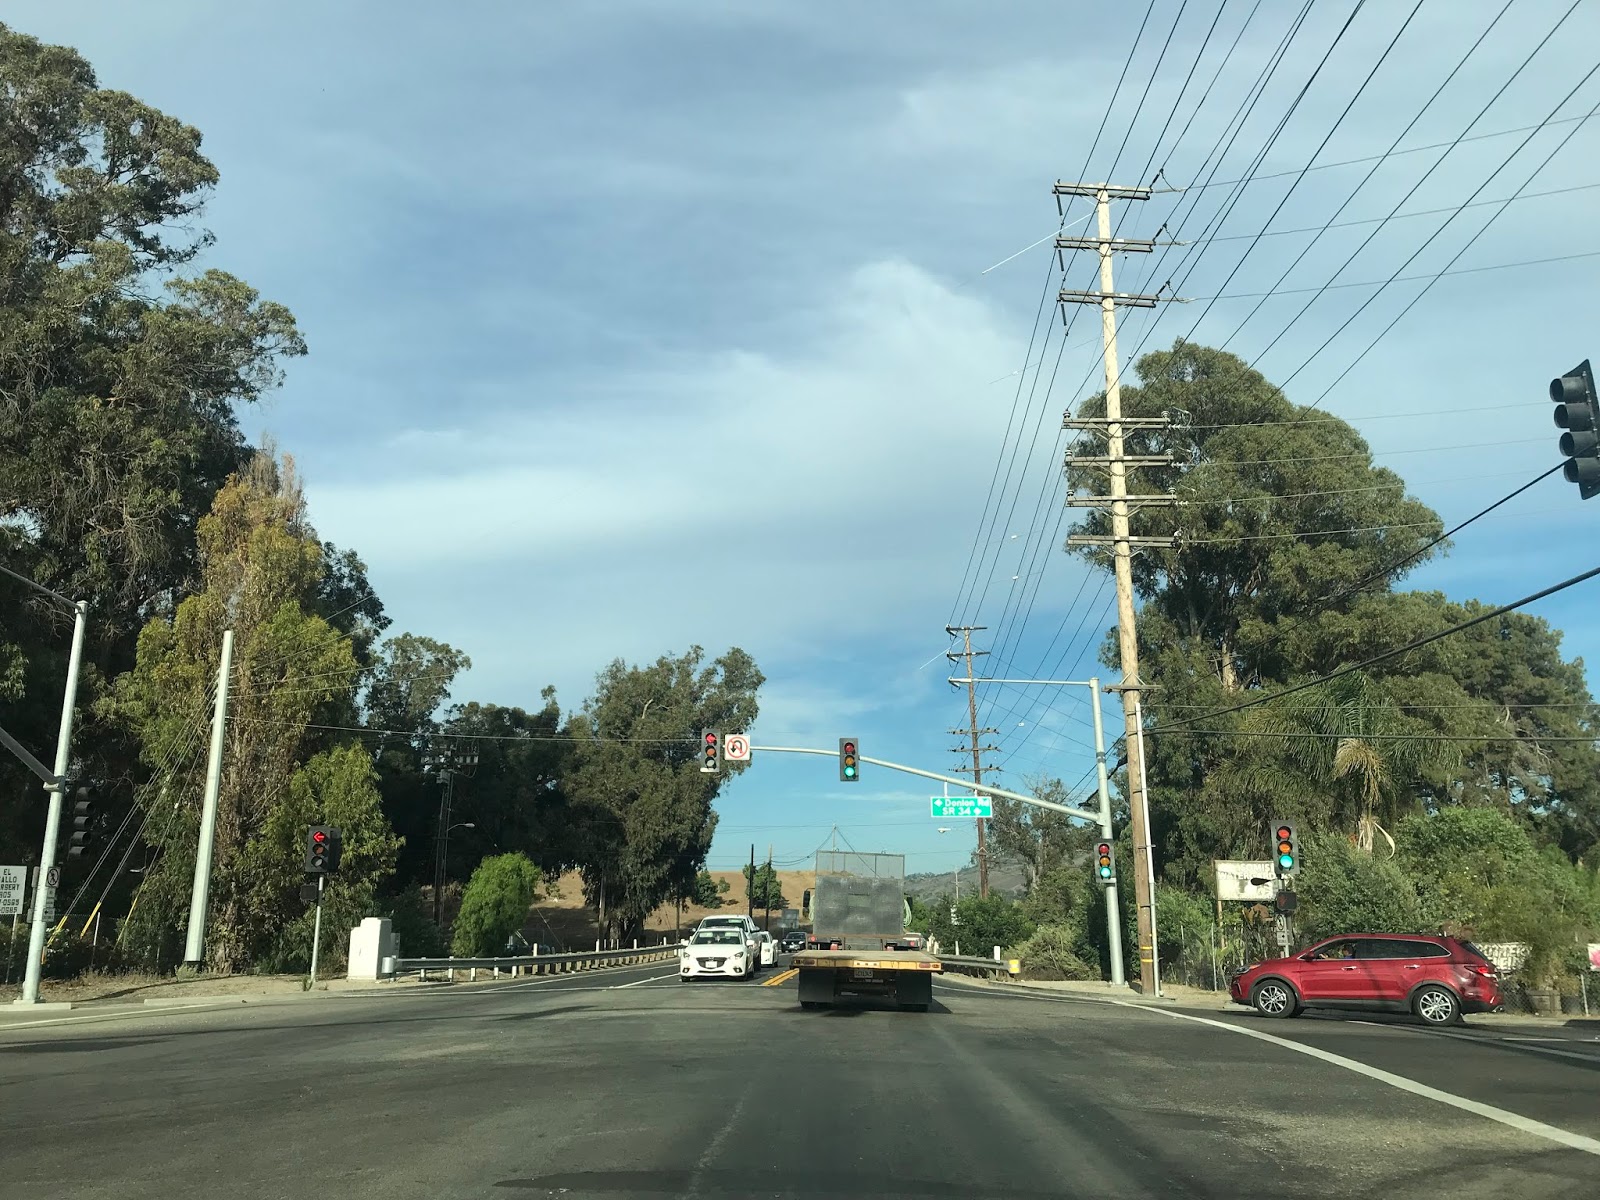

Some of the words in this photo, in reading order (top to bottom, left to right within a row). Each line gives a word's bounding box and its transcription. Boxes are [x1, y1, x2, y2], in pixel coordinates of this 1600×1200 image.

[977, 798, 991, 807] Rd
[942, 807, 956, 816] SR
[958, 807, 972, 816] 34
[3, 868, 12, 876] EL
[0, 876, 18, 884] ALLO
